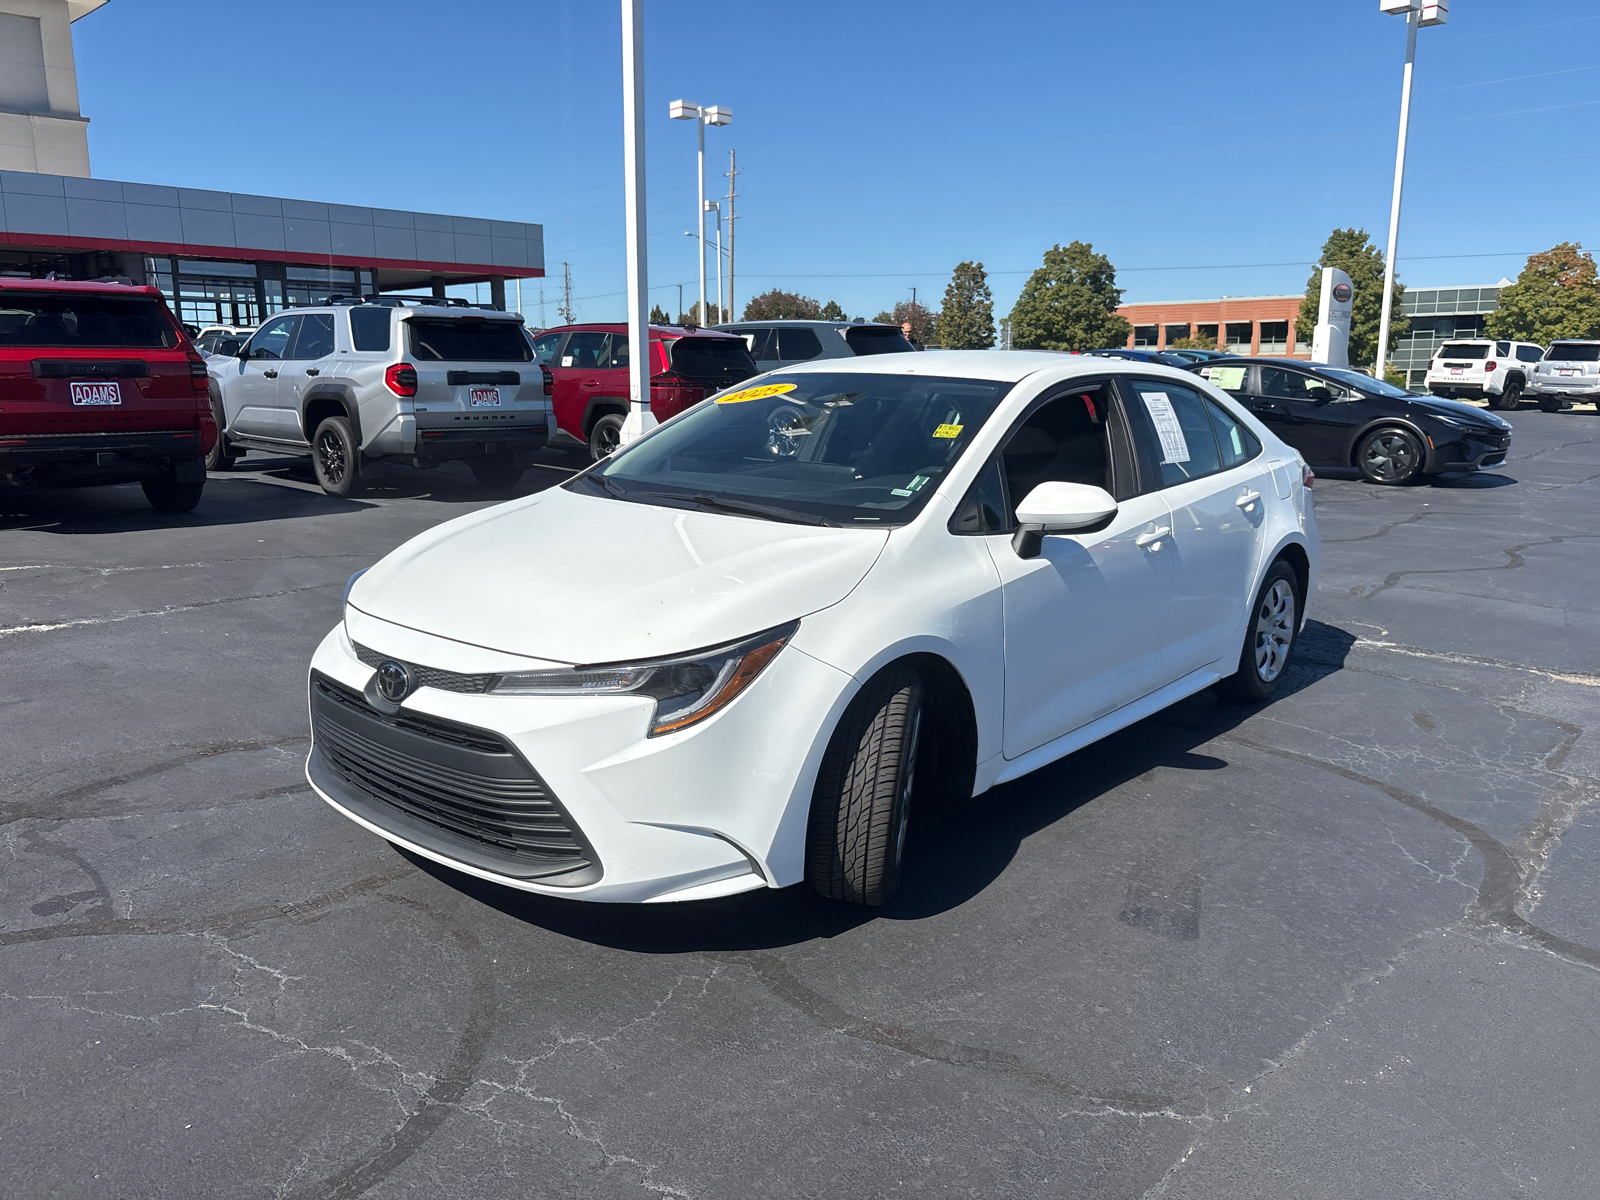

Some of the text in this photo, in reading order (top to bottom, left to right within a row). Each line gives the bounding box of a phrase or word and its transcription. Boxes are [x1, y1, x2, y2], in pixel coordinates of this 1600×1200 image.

[75, 386, 117, 402] ADAMS
[472, 391, 498, 404] ADAMS
[723, 385, 788, 402] 2025
